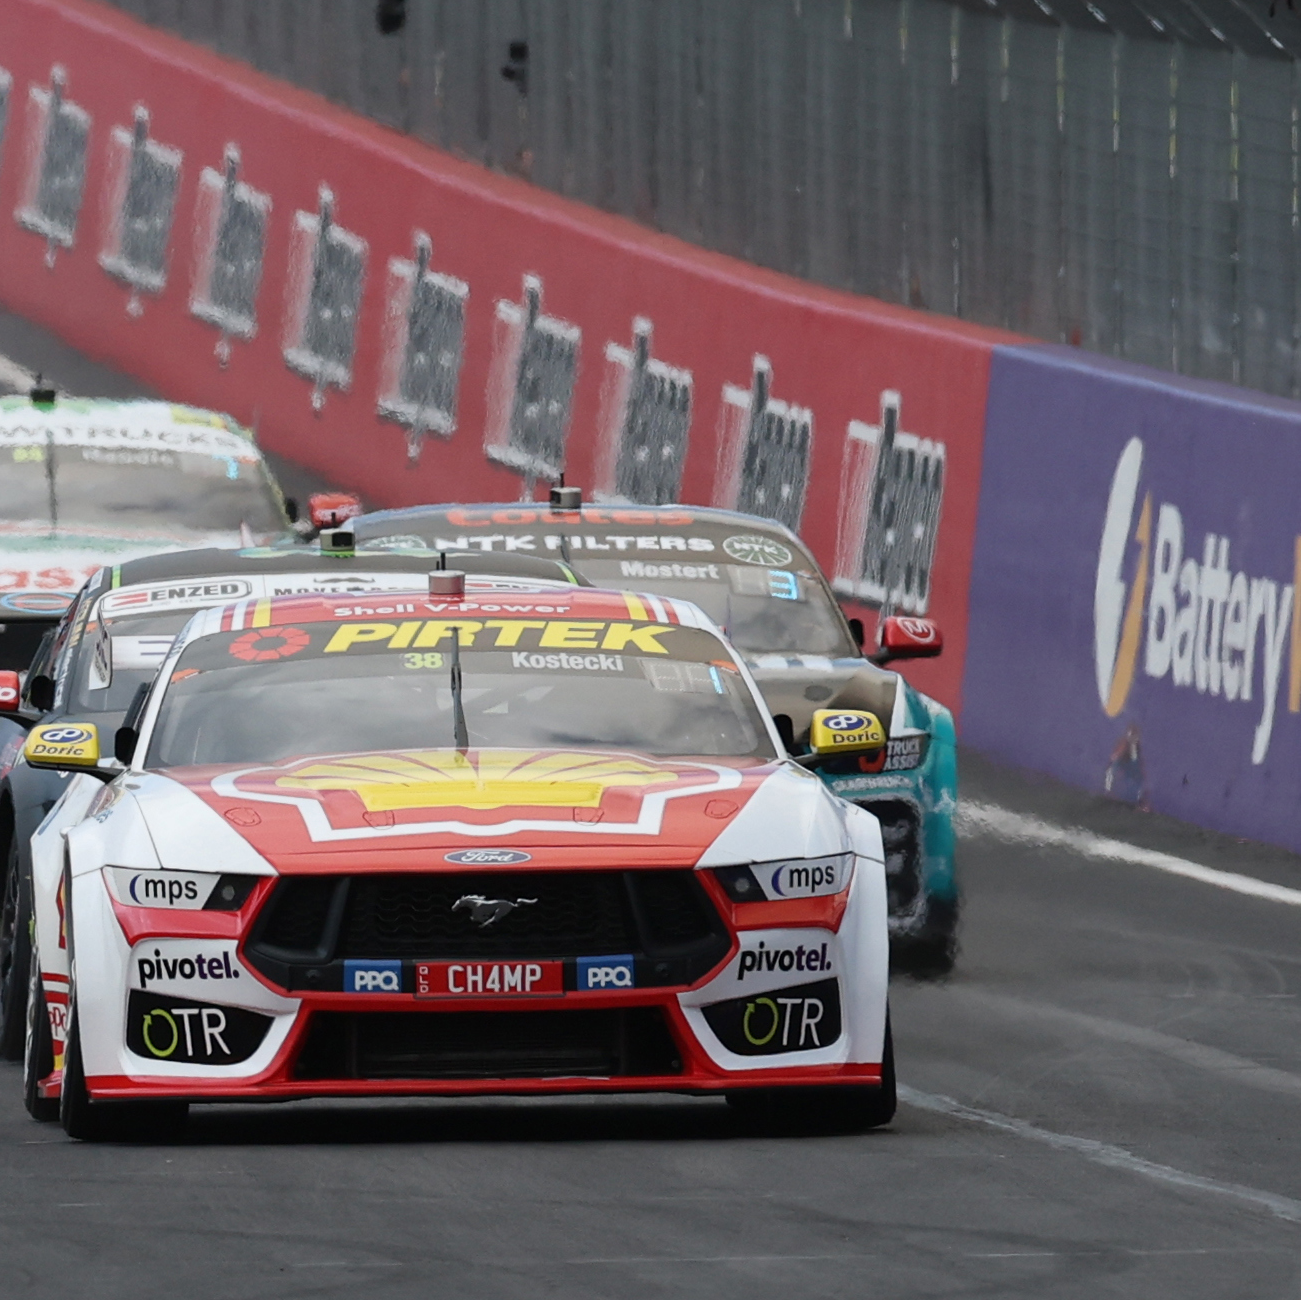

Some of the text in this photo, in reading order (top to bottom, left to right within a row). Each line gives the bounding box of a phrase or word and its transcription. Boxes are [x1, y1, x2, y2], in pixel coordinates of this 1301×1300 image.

[544, 535, 715, 553] FILTERS
[620, 560, 720, 580] Mostert
[150, 584, 239, 601] ENZED
[334, 603, 570, 617] Shell V-Power
[323, 620, 676, 654] PIRTEK
[1145, 503, 1293, 766] Battery
[404, 653, 624, 672] 38 Kostecki
[832, 731, 880, 744] Doric
[32, 745, 84, 756] Doric
[788, 865, 835, 890] mps
[144, 877, 198, 905] mps
[354, 970, 400, 992] PPQ
[447, 964, 542, 993] CH4MP
[588, 966, 632, 987] PPQ
[743, 997, 824, 1047] OTR
[143, 1008, 231, 1058] OTR
